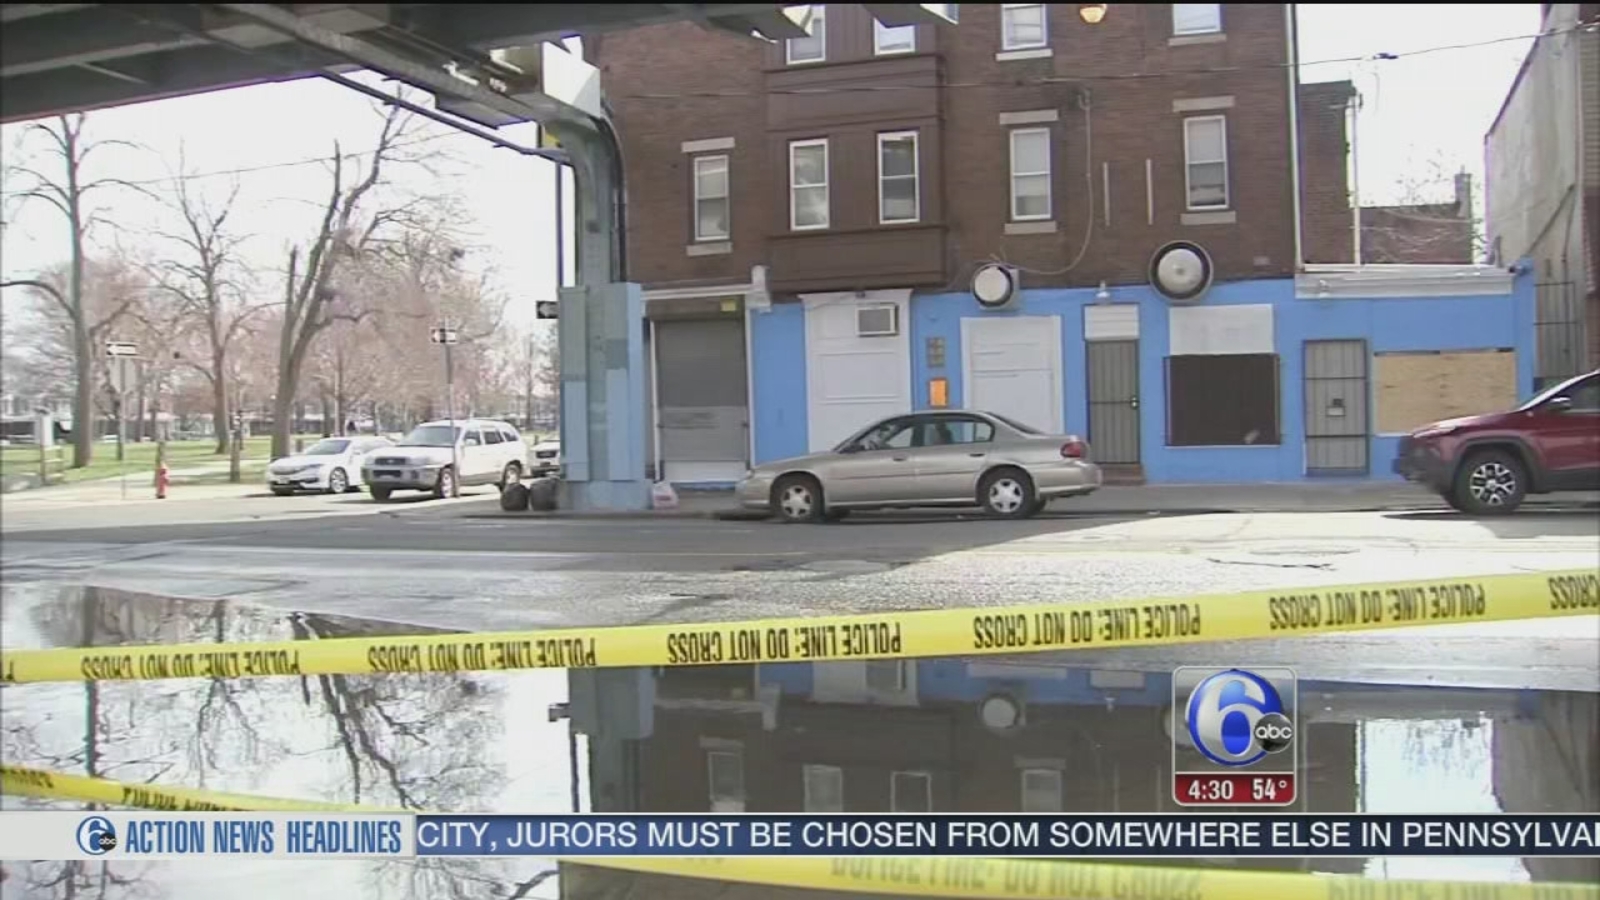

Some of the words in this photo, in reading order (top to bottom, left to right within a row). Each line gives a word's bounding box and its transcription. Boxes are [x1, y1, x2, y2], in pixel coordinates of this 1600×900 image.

[1269, 596, 1321, 630] CROSS
[1325, 592, 1356, 626] NOT
[1361, 591, 1381, 623] DO
[1430, 584, 1486, 618] POLICE
[973, 615, 1028, 649] CROSS
[1033, 612, 1066, 646] NOT
[1070, 610, 1092, 643] DO
[1144, 603, 1200, 637] POLICE
[536, 637, 597, 666] POLICE
[667, 631, 723, 664] CROSS
[729, 629, 760, 661] NOT
[766, 627, 790, 659] DO
[794, 625, 837, 657] LINE:
[842, 622, 901, 655] POLICE
[81, 656, 134, 680] CROSS
[140, 655, 169, 679] NOT
[173, 654, 194, 678] DO
[244, 650, 300, 676] POLICE
[367, 645, 420, 672] CROSS
[429, 643, 458, 671] NOT
[463, 642, 486, 670] DO
